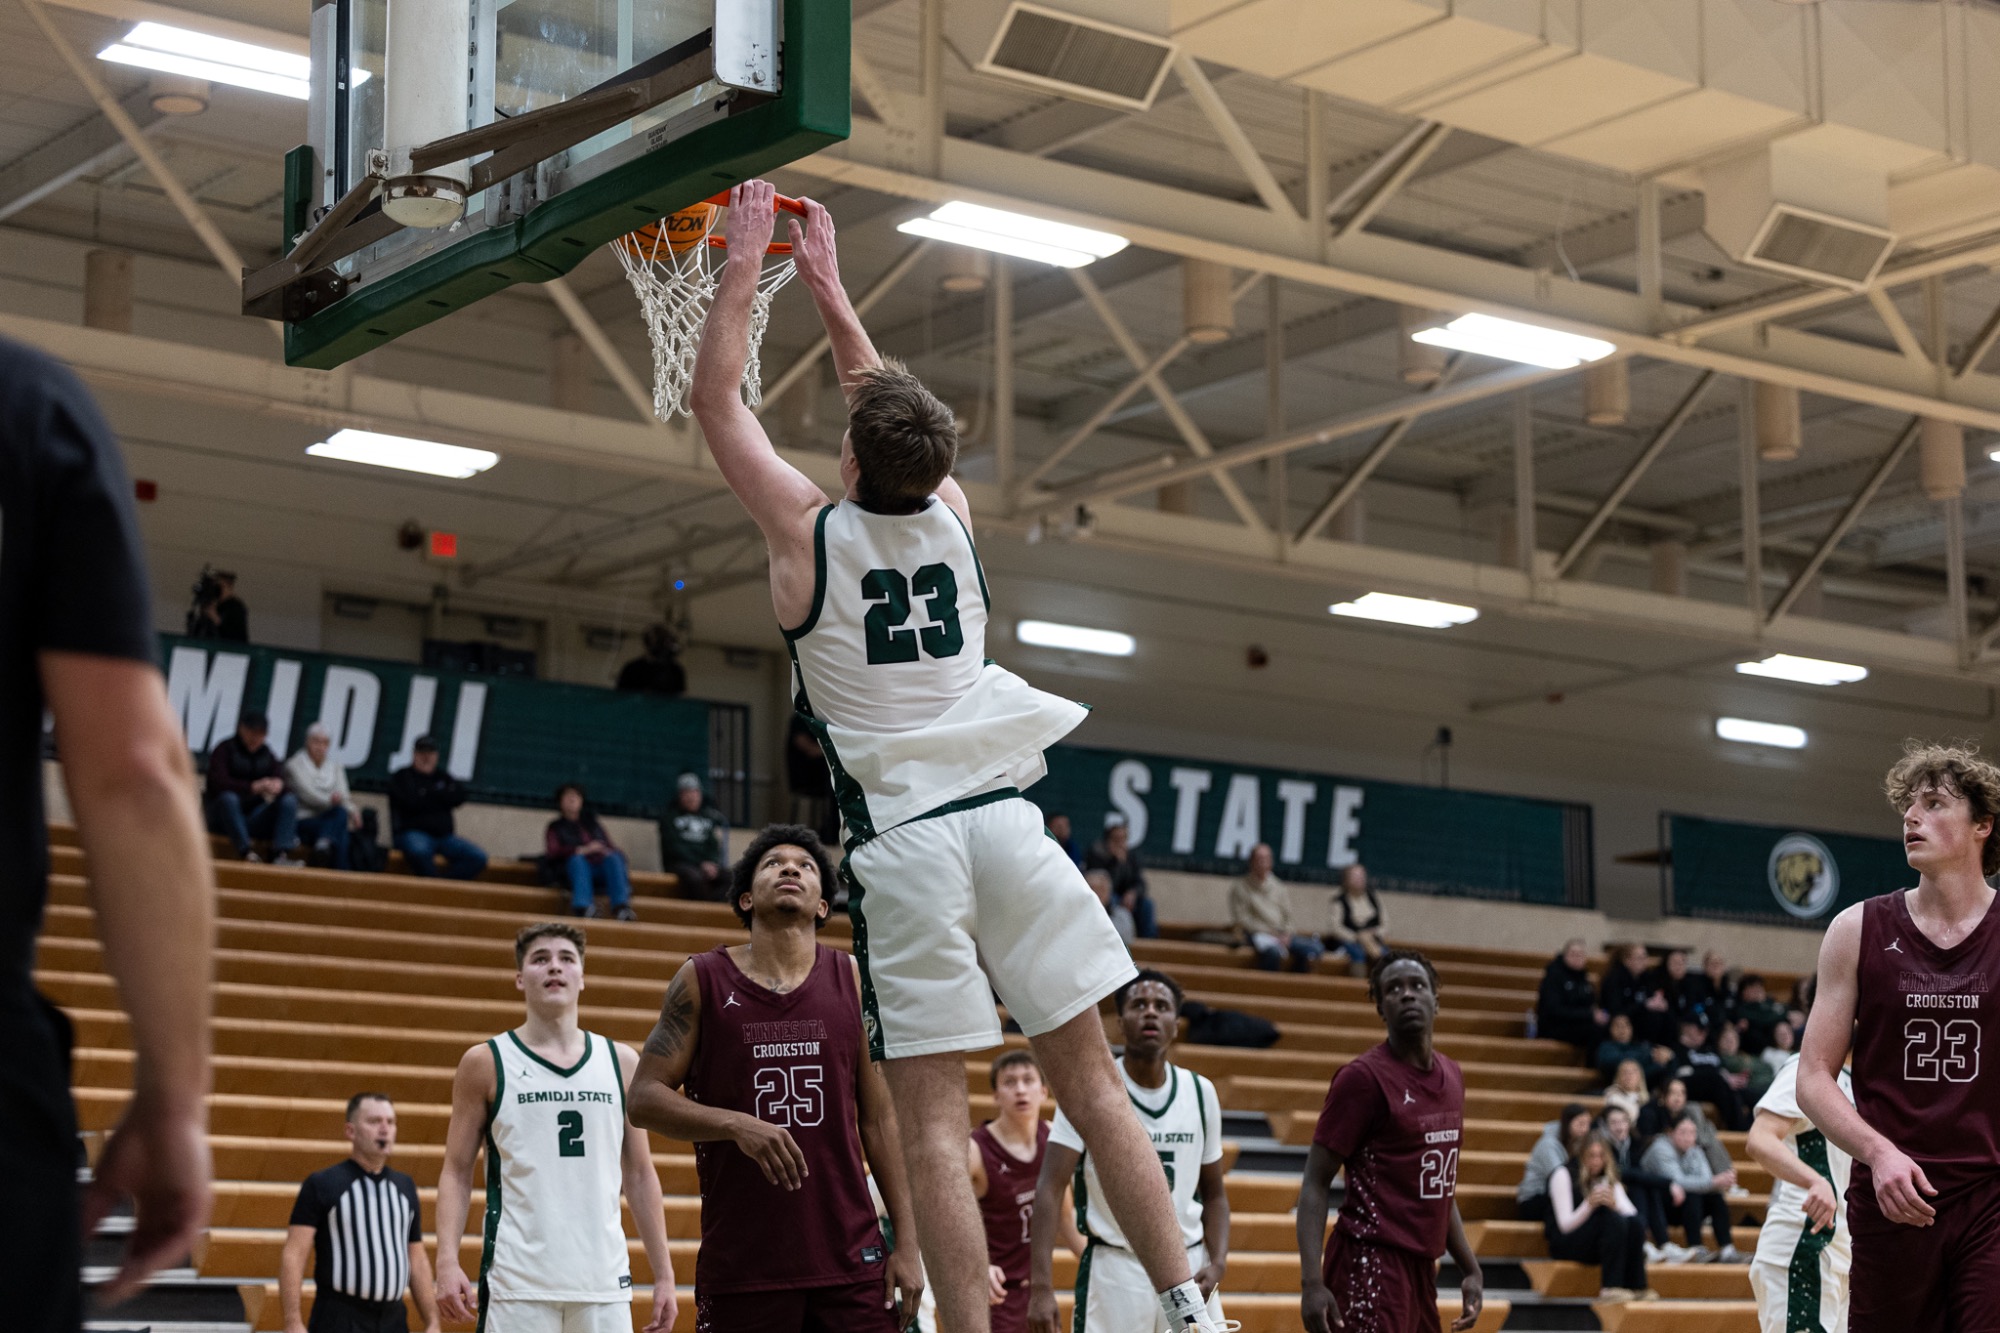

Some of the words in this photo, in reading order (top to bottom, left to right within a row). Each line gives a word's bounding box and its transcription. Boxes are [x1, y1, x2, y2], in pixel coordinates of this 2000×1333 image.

[861, 562, 964, 665] 23
[167, 646, 488, 782] MIDJI
[1103, 759, 1365, 868] STATE
[1898, 971, 1989, 993] MINNESOTA
[1906, 994, 1980, 1009] CROOKSTON
[742, 1019, 828, 1044] MINNESOTA
[753, 1042, 820, 1058] CROOKSTON
[1904, 1018, 1981, 1083] 23
[517, 1091, 575, 1105] BEMIDJI
[577, 1091, 614, 1105] STATE
[754, 1065, 824, 1127] 25
[557, 1110, 586, 1157] 2
[1420, 1147, 1459, 1199] 24
